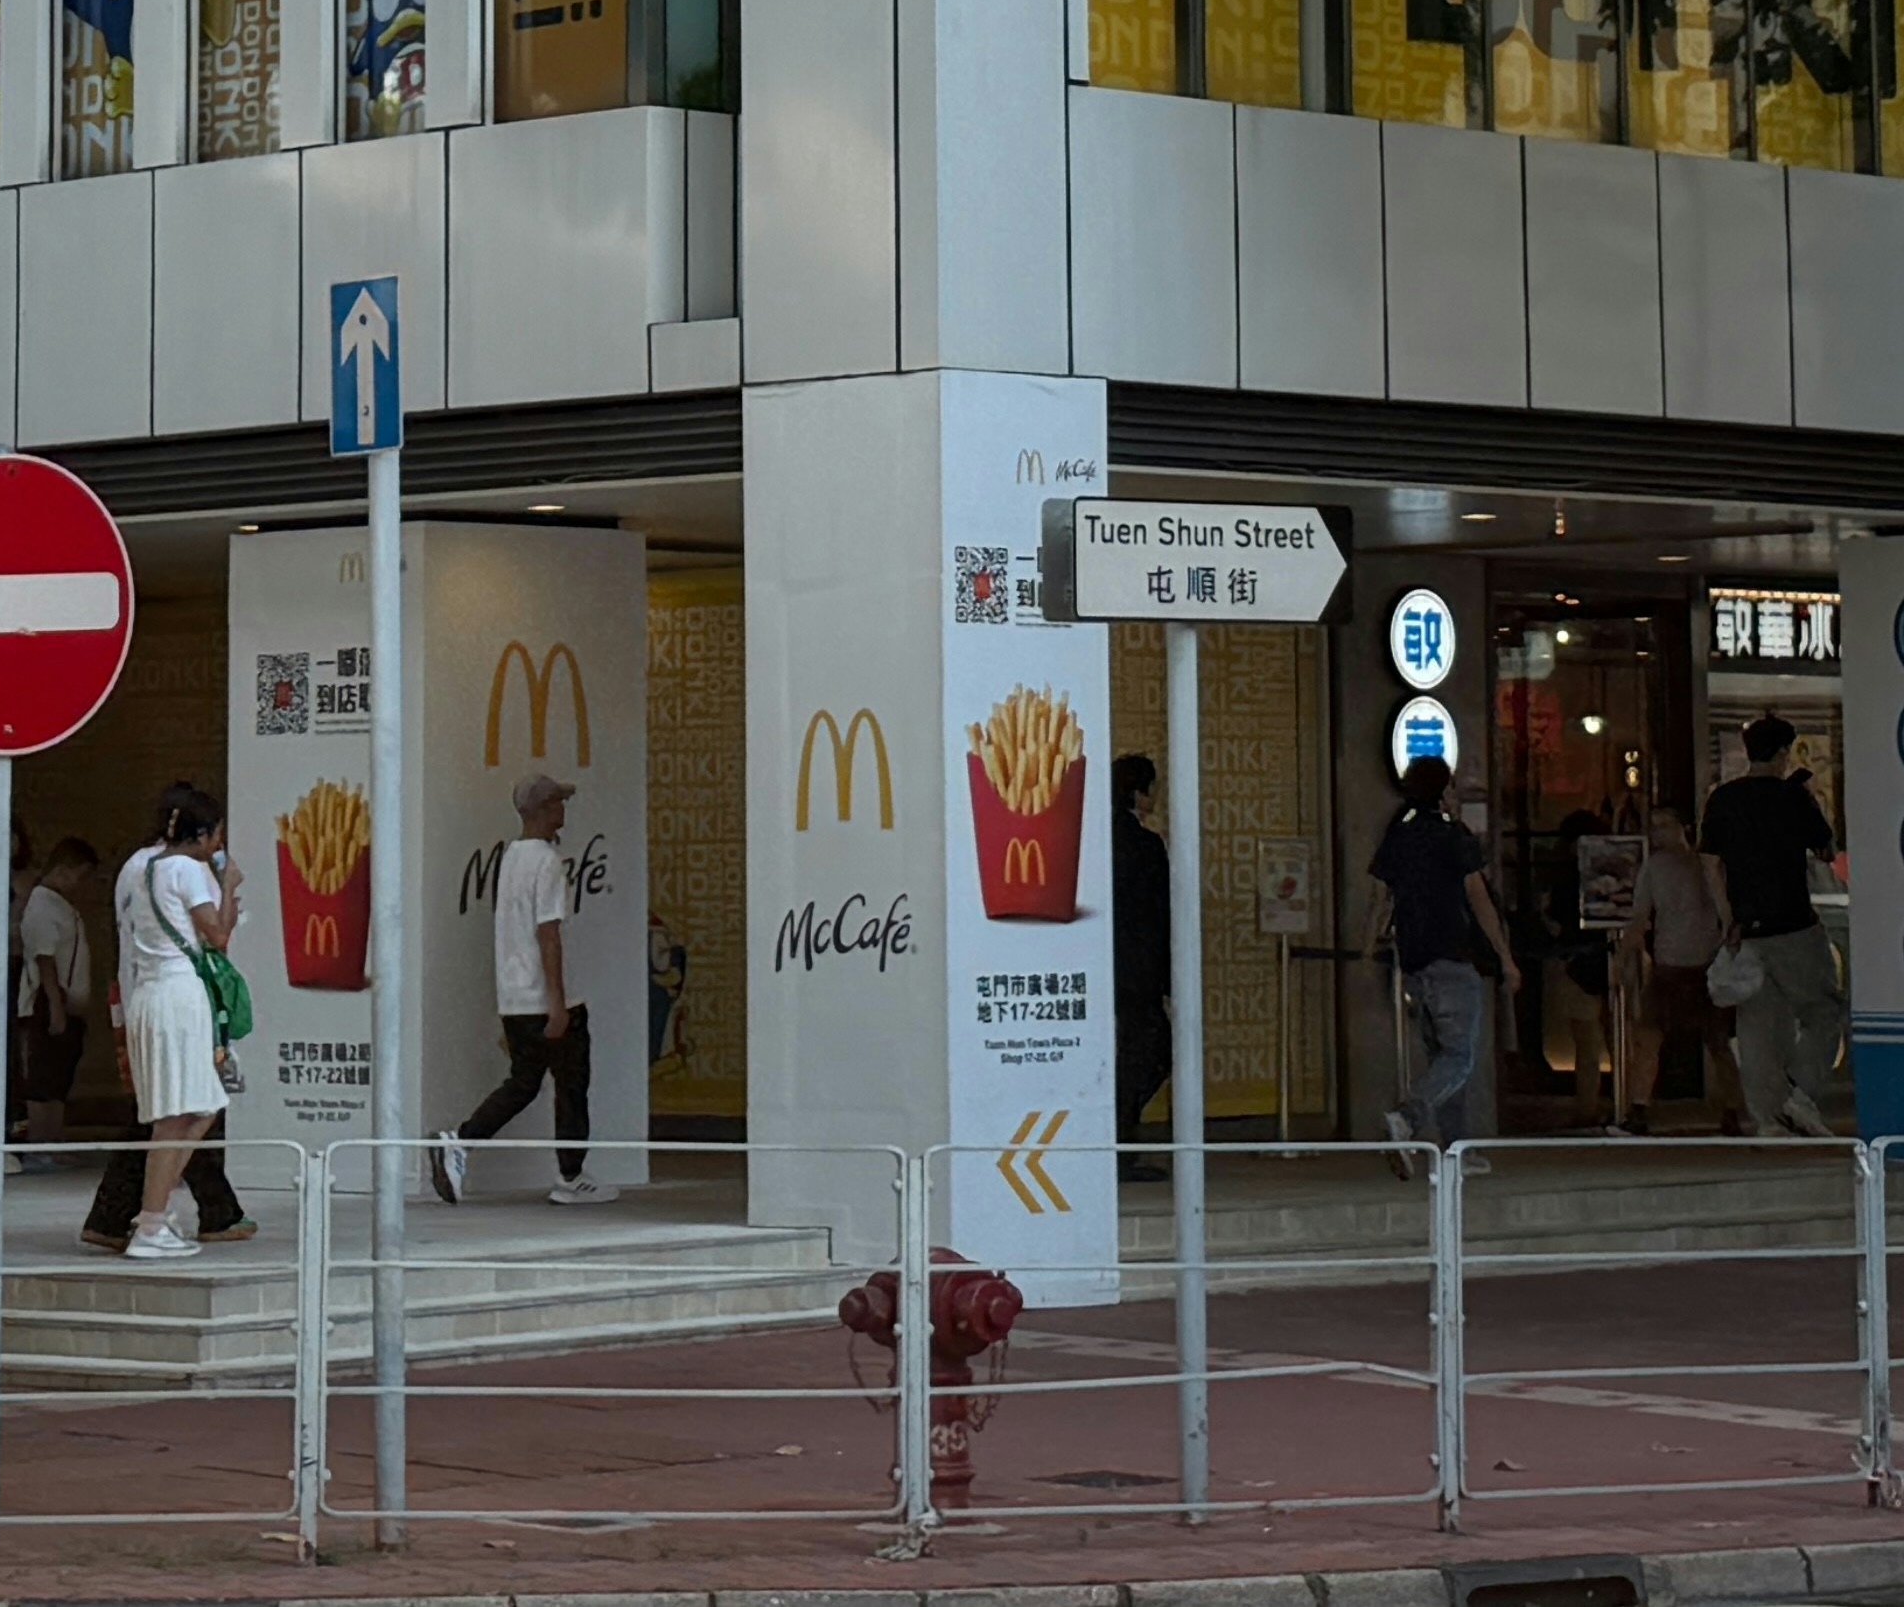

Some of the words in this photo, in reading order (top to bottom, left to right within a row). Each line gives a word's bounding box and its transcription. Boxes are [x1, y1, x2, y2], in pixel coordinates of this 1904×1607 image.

[1084, 513, 1148, 547] Tuen
[1157, 517, 1225, 549] Shun
[1233, 519, 1316, 551] Street
[1145, 564, 1258, 607] 屯順街
[775, 893, 918, 973] McCafé
